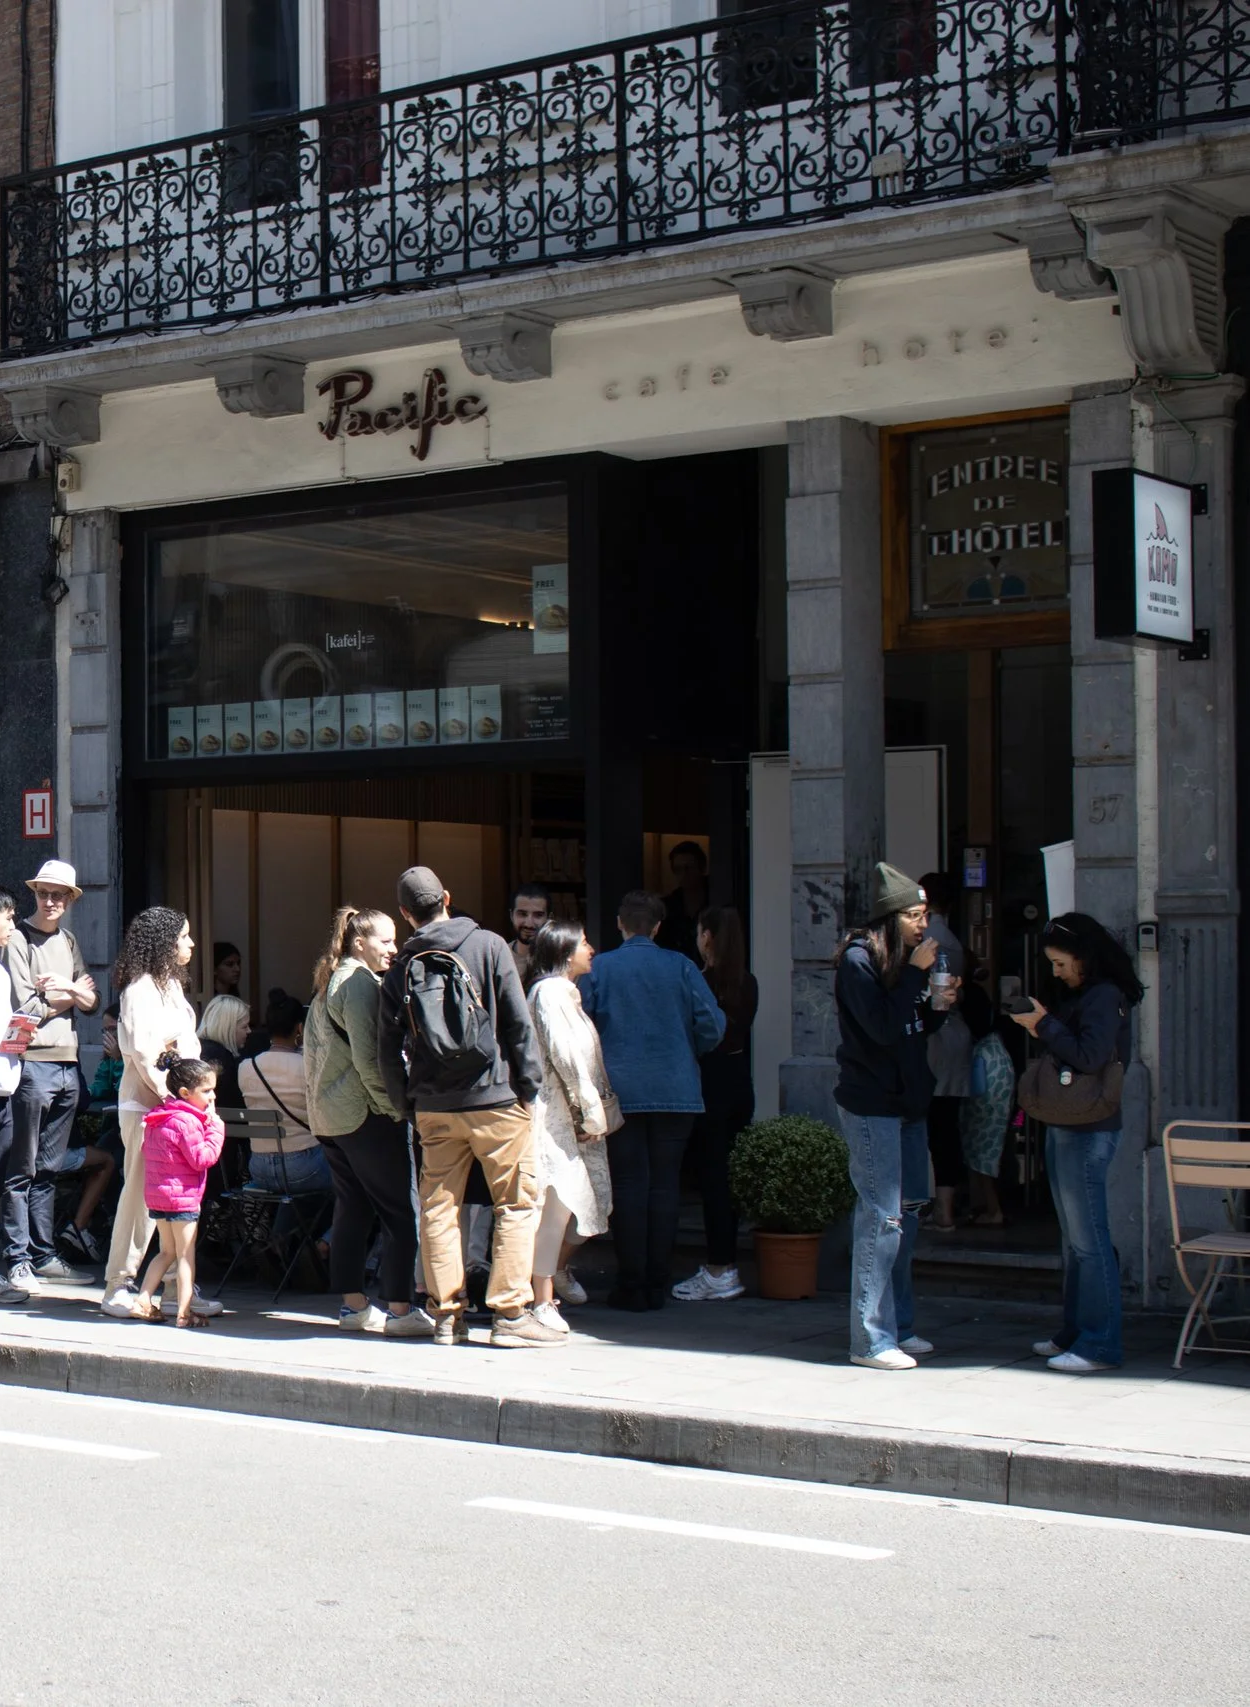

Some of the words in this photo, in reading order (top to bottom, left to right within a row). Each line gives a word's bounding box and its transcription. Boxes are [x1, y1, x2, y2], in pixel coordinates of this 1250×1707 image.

[860, 316, 1039, 368] hote
[315, 368, 488, 461] Pacific
[930, 455, 1060, 497] ENTREE
[973, 495, 1016, 512] DE
[535, 579, 555, 589] FREE
[1147, 545, 1178, 587] KOMO
[29, 798, 46, 829] H
[1089, 793, 1125, 825] 57
